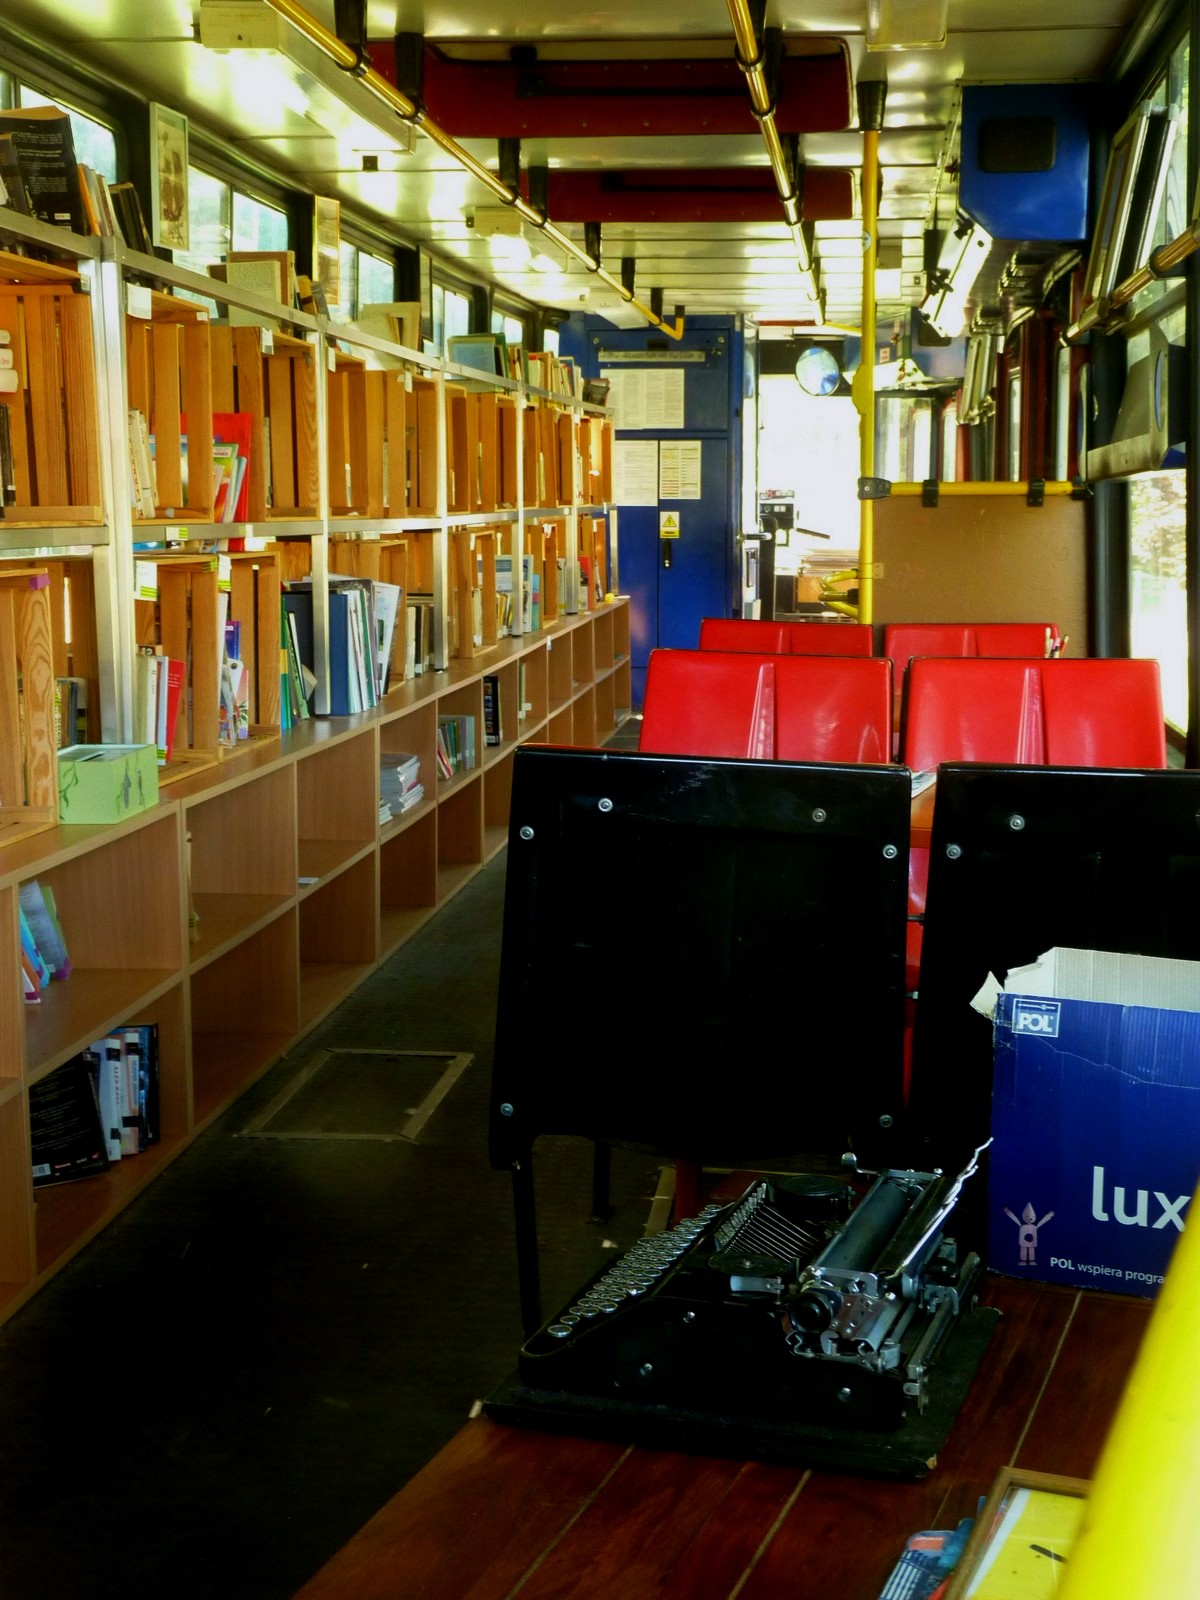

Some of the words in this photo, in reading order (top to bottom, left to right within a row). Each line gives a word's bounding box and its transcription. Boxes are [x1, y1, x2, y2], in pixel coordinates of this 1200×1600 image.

[1016, 1012, 1053, 1033] POL
[1092, 1165, 1192, 1233] lux
[1050, 1256, 1076, 1270] POL
[1077, 1263, 1123, 1278] wspiera
[1124, 1270, 1166, 1285] progra
